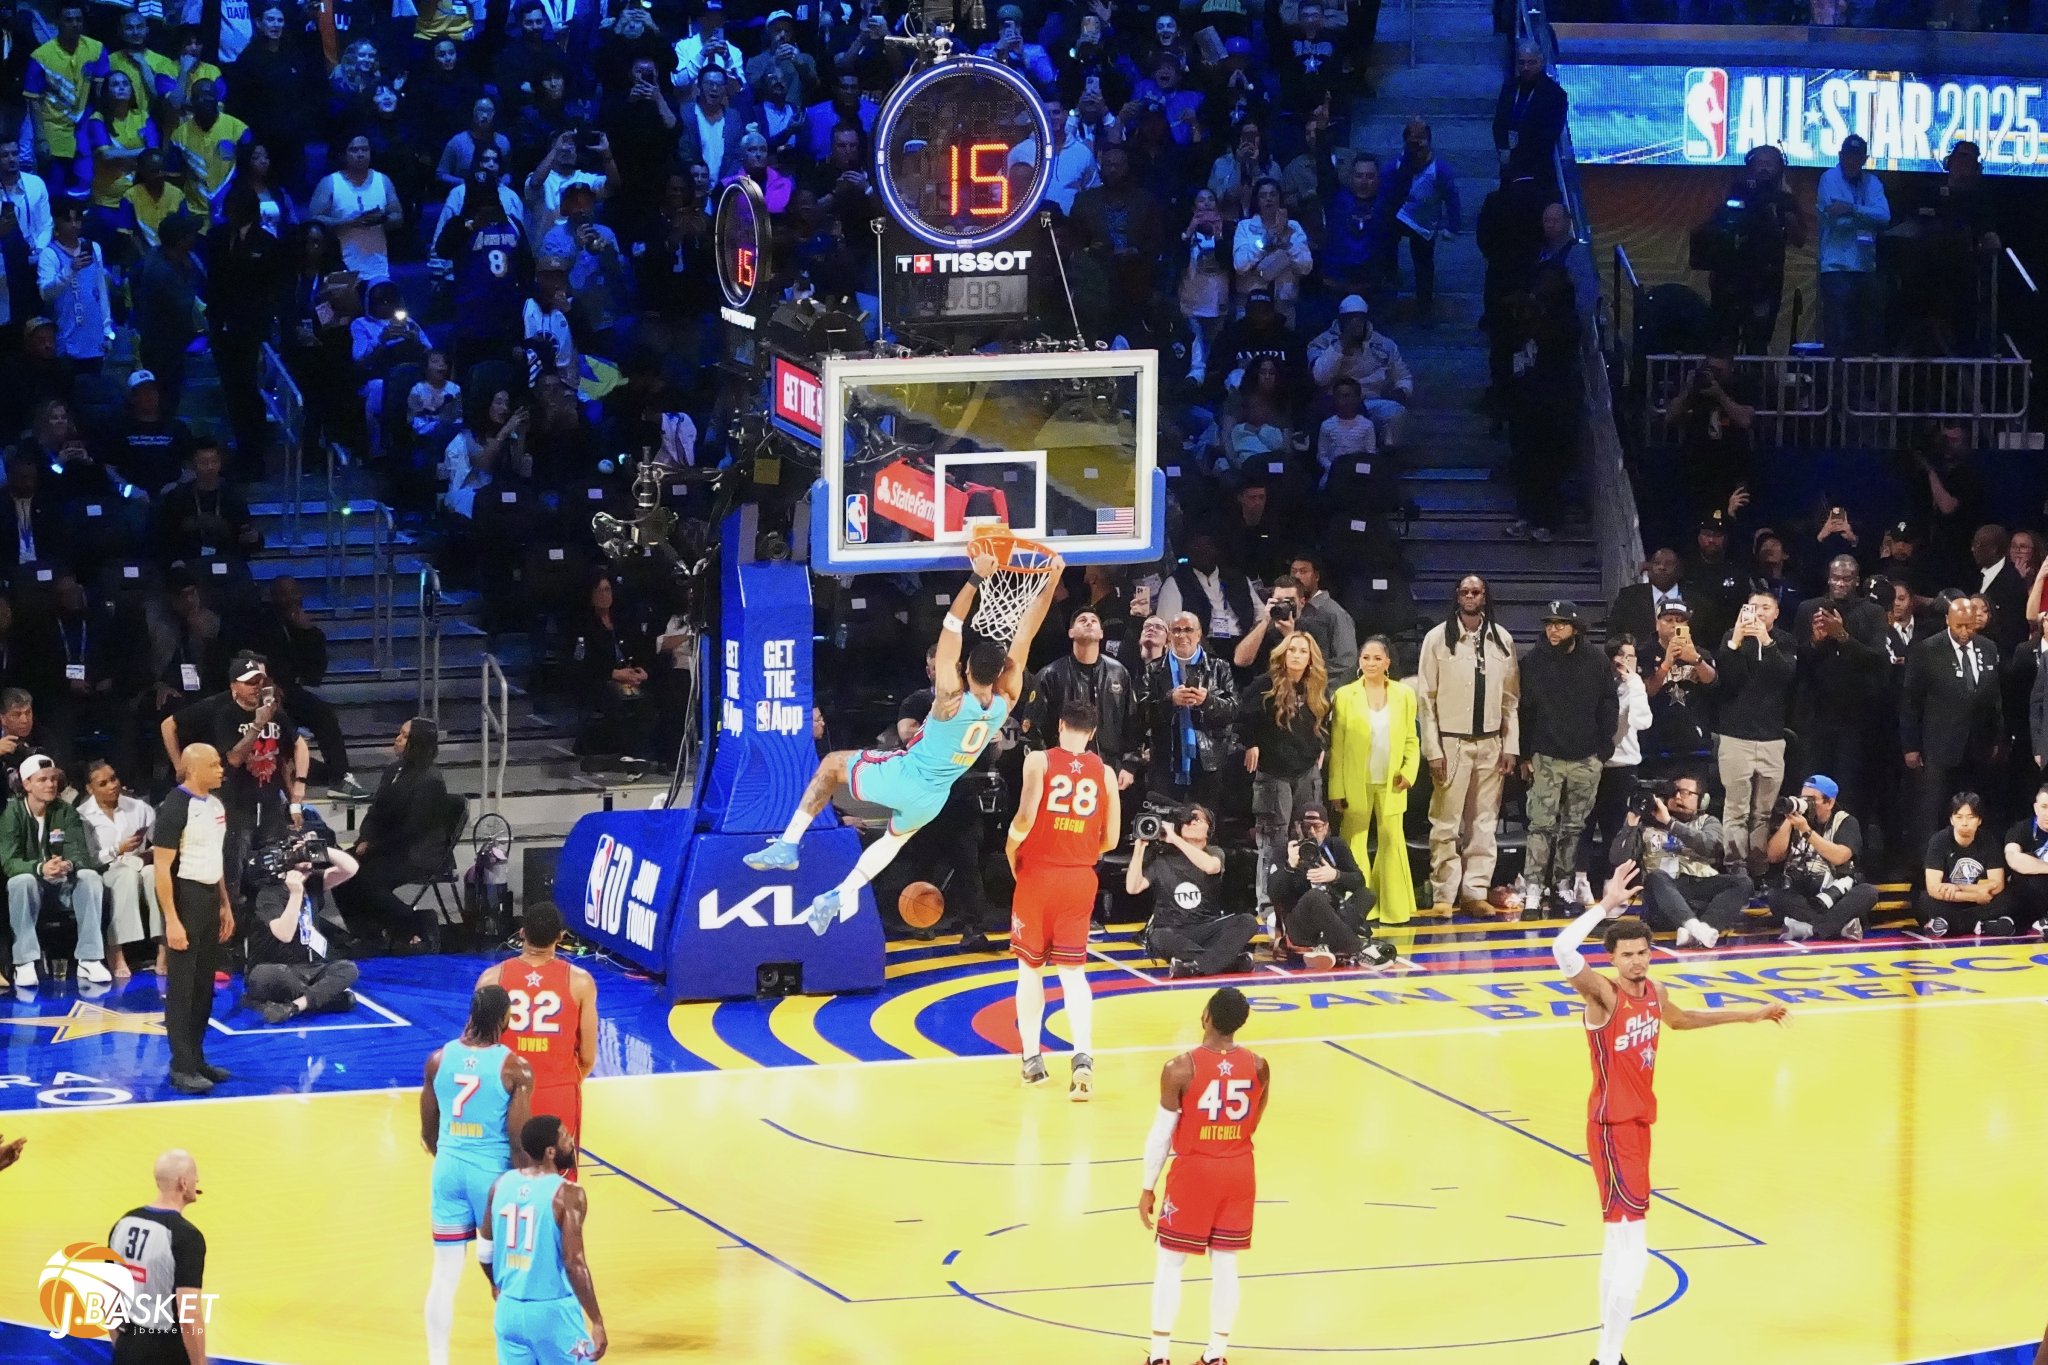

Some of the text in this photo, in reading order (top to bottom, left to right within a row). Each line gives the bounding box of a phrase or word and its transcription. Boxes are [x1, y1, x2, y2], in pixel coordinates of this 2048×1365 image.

[1820, 78, 1934, 161] STAR
[1938, 82, 2041, 166] 2025
[950, 142, 1009, 216] 15
[488, 249, 508, 278] 8
[737, 247, 753, 287] 15
[933, 250, 1032, 273] TISSOT
[784, 372, 816, 422] GET THE
[763, 639, 796, 669] GET
[763, 669, 796, 699] THE
[770, 700, 803, 736] App
[960, 720, 990, 754] 0
[1046, 774, 1099, 817] 28
[631, 858, 661, 904] JOIN
[1174, 890, 1201, 903] TNT
[626, 899, 658, 951] TODAY
[508, 989, 562, 1033] 32
[1247, 987, 1457, 1013] SAN
[1700, 979, 1986, 1008] AREA
[1613, 1018, 1659, 1052] STAR
[1625, 1009, 1654, 1034] ALL
[517, 1036, 549, 1052] TOWNS
[451, 1073, 481, 1118] 7
[1197, 1079, 1254, 1122] 45
[1200, 1124, 1242, 1141] MITCHELL
[125, 1226, 150, 1262] 37
[499, 1202, 536, 1252] 11
